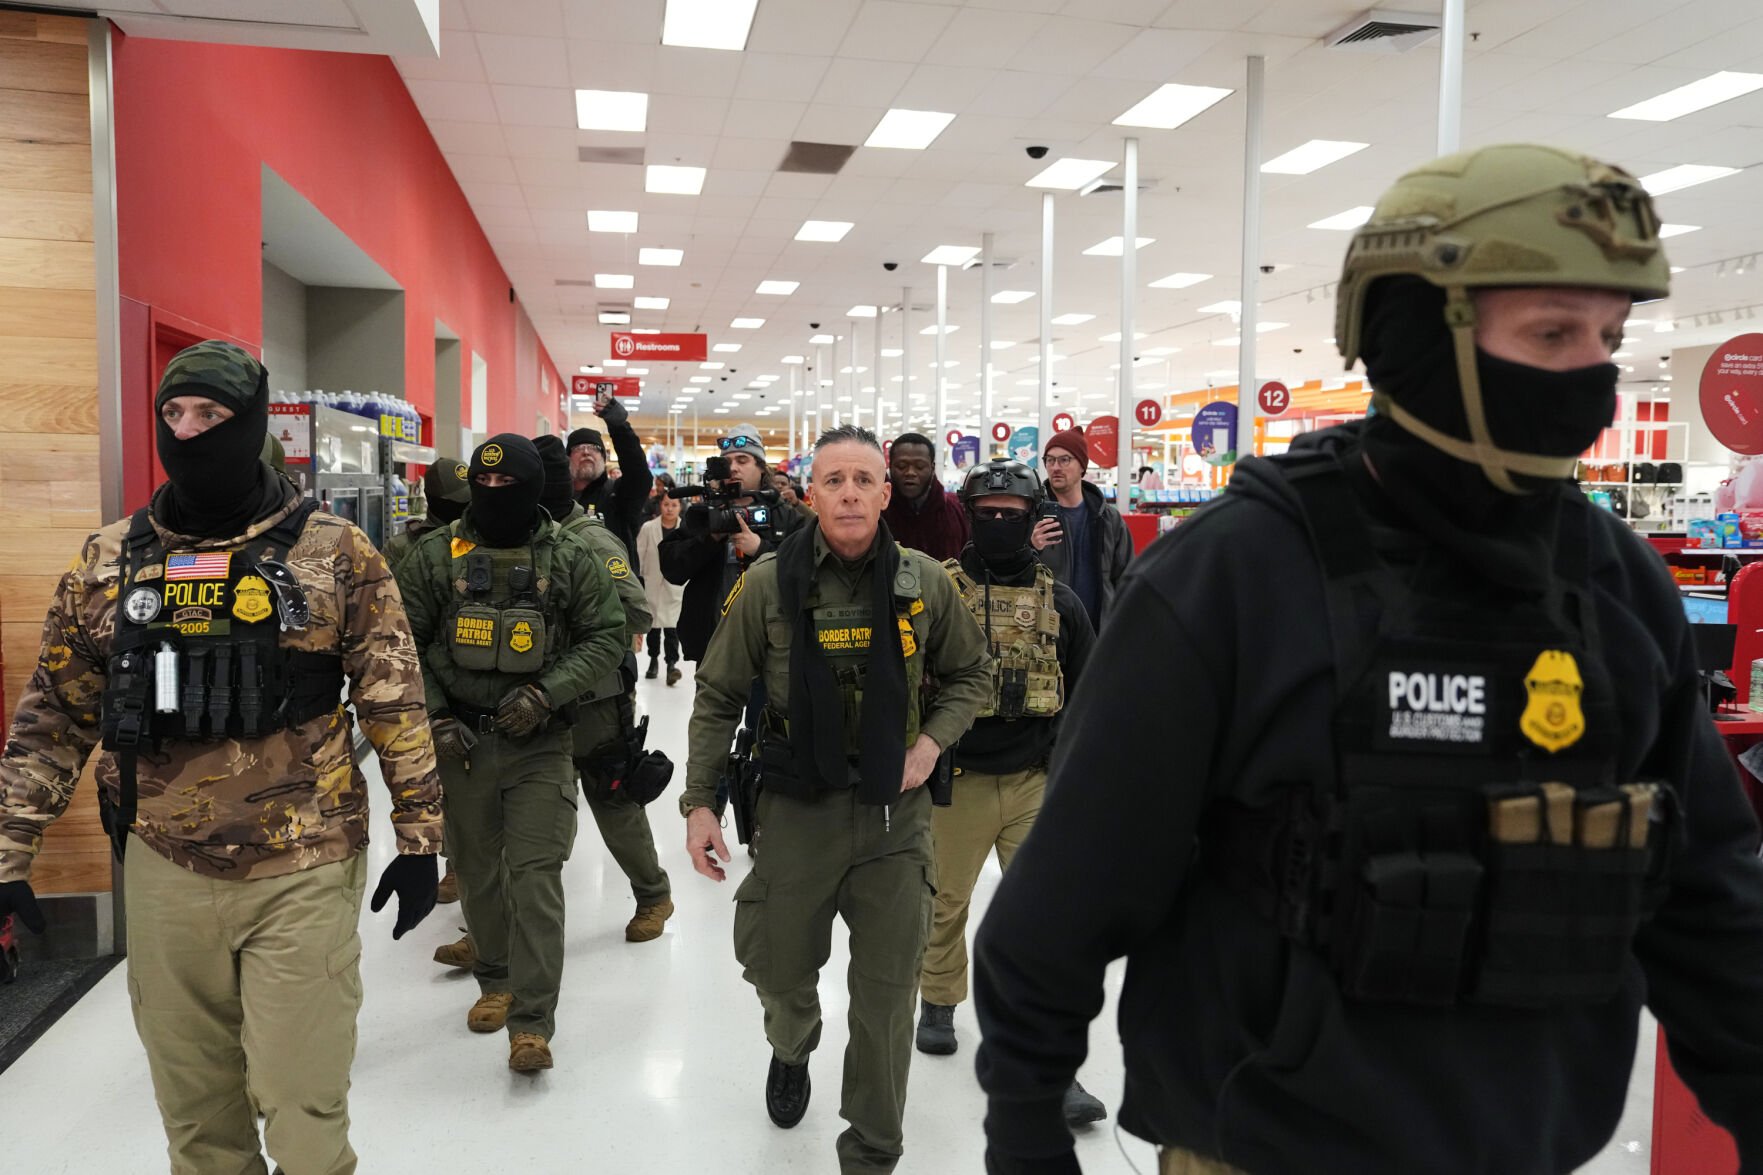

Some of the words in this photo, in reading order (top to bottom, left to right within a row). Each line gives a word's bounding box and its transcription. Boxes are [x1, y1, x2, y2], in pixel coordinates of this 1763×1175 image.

[635, 342, 680, 351] Restrooms
[1263, 390, 1285, 407] 12
[1141, 406, 1156, 420] 11
[1055, 417, 1071, 431] 10
[163, 582, 225, 606] POLICE
[978, 598, 1012, 613] PLICE
[457, 617, 494, 630] BORDER
[456, 628, 493, 641] PATROL
[818, 628, 850, 643] BORDER
[851, 627, 872, 640] PATR
[823, 642, 854, 650] FEDERAL
[1388, 671, 1487, 715] POLICE
